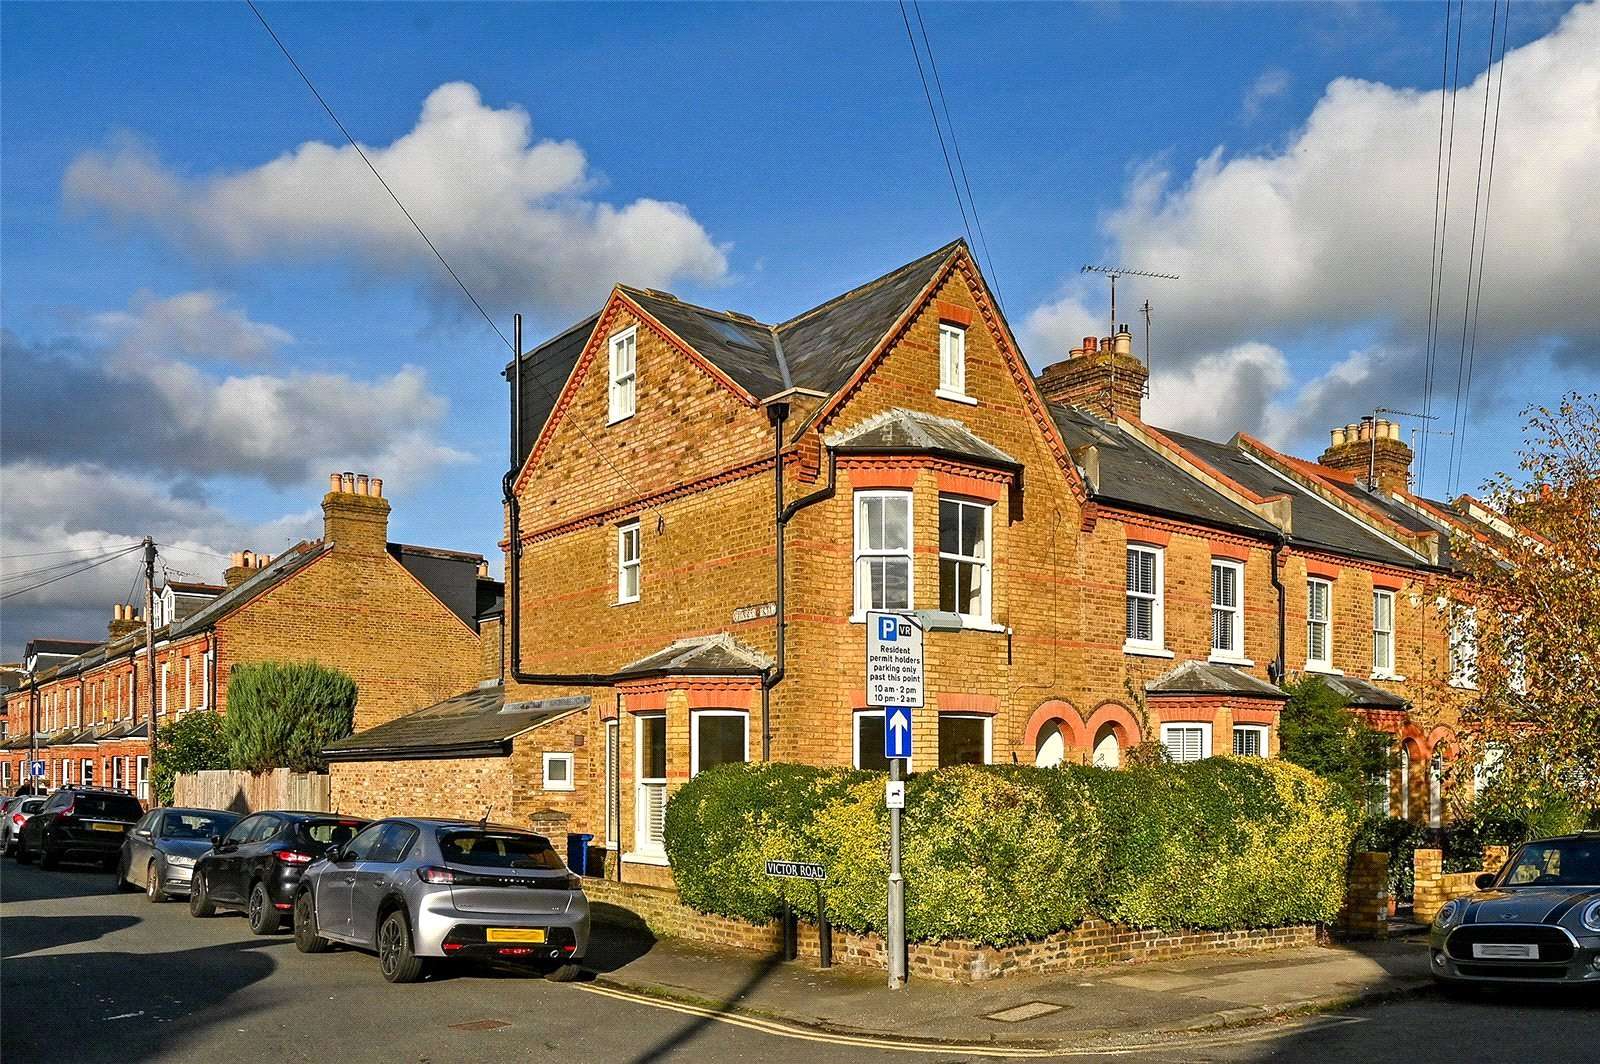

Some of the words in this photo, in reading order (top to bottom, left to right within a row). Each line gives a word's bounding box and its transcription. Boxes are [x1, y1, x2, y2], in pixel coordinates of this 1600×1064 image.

[883, 619, 895, 639] P
[900, 625, 911, 635] VR
[880, 645, 911, 654] Resident
[870, 655, 893, 663] permit
[895, 656, 920, 665] holders
[873, 664, 900, 674] parking
[902, 665, 917, 674] only
[888, 674, 901, 682] this
[902, 675, 920, 683] point
[874, 684, 883, 692] 10
[874, 693, 883, 702] 10
[767, 863, 798, 876] VICTOR
[800, 865, 824, 878] ROAD
